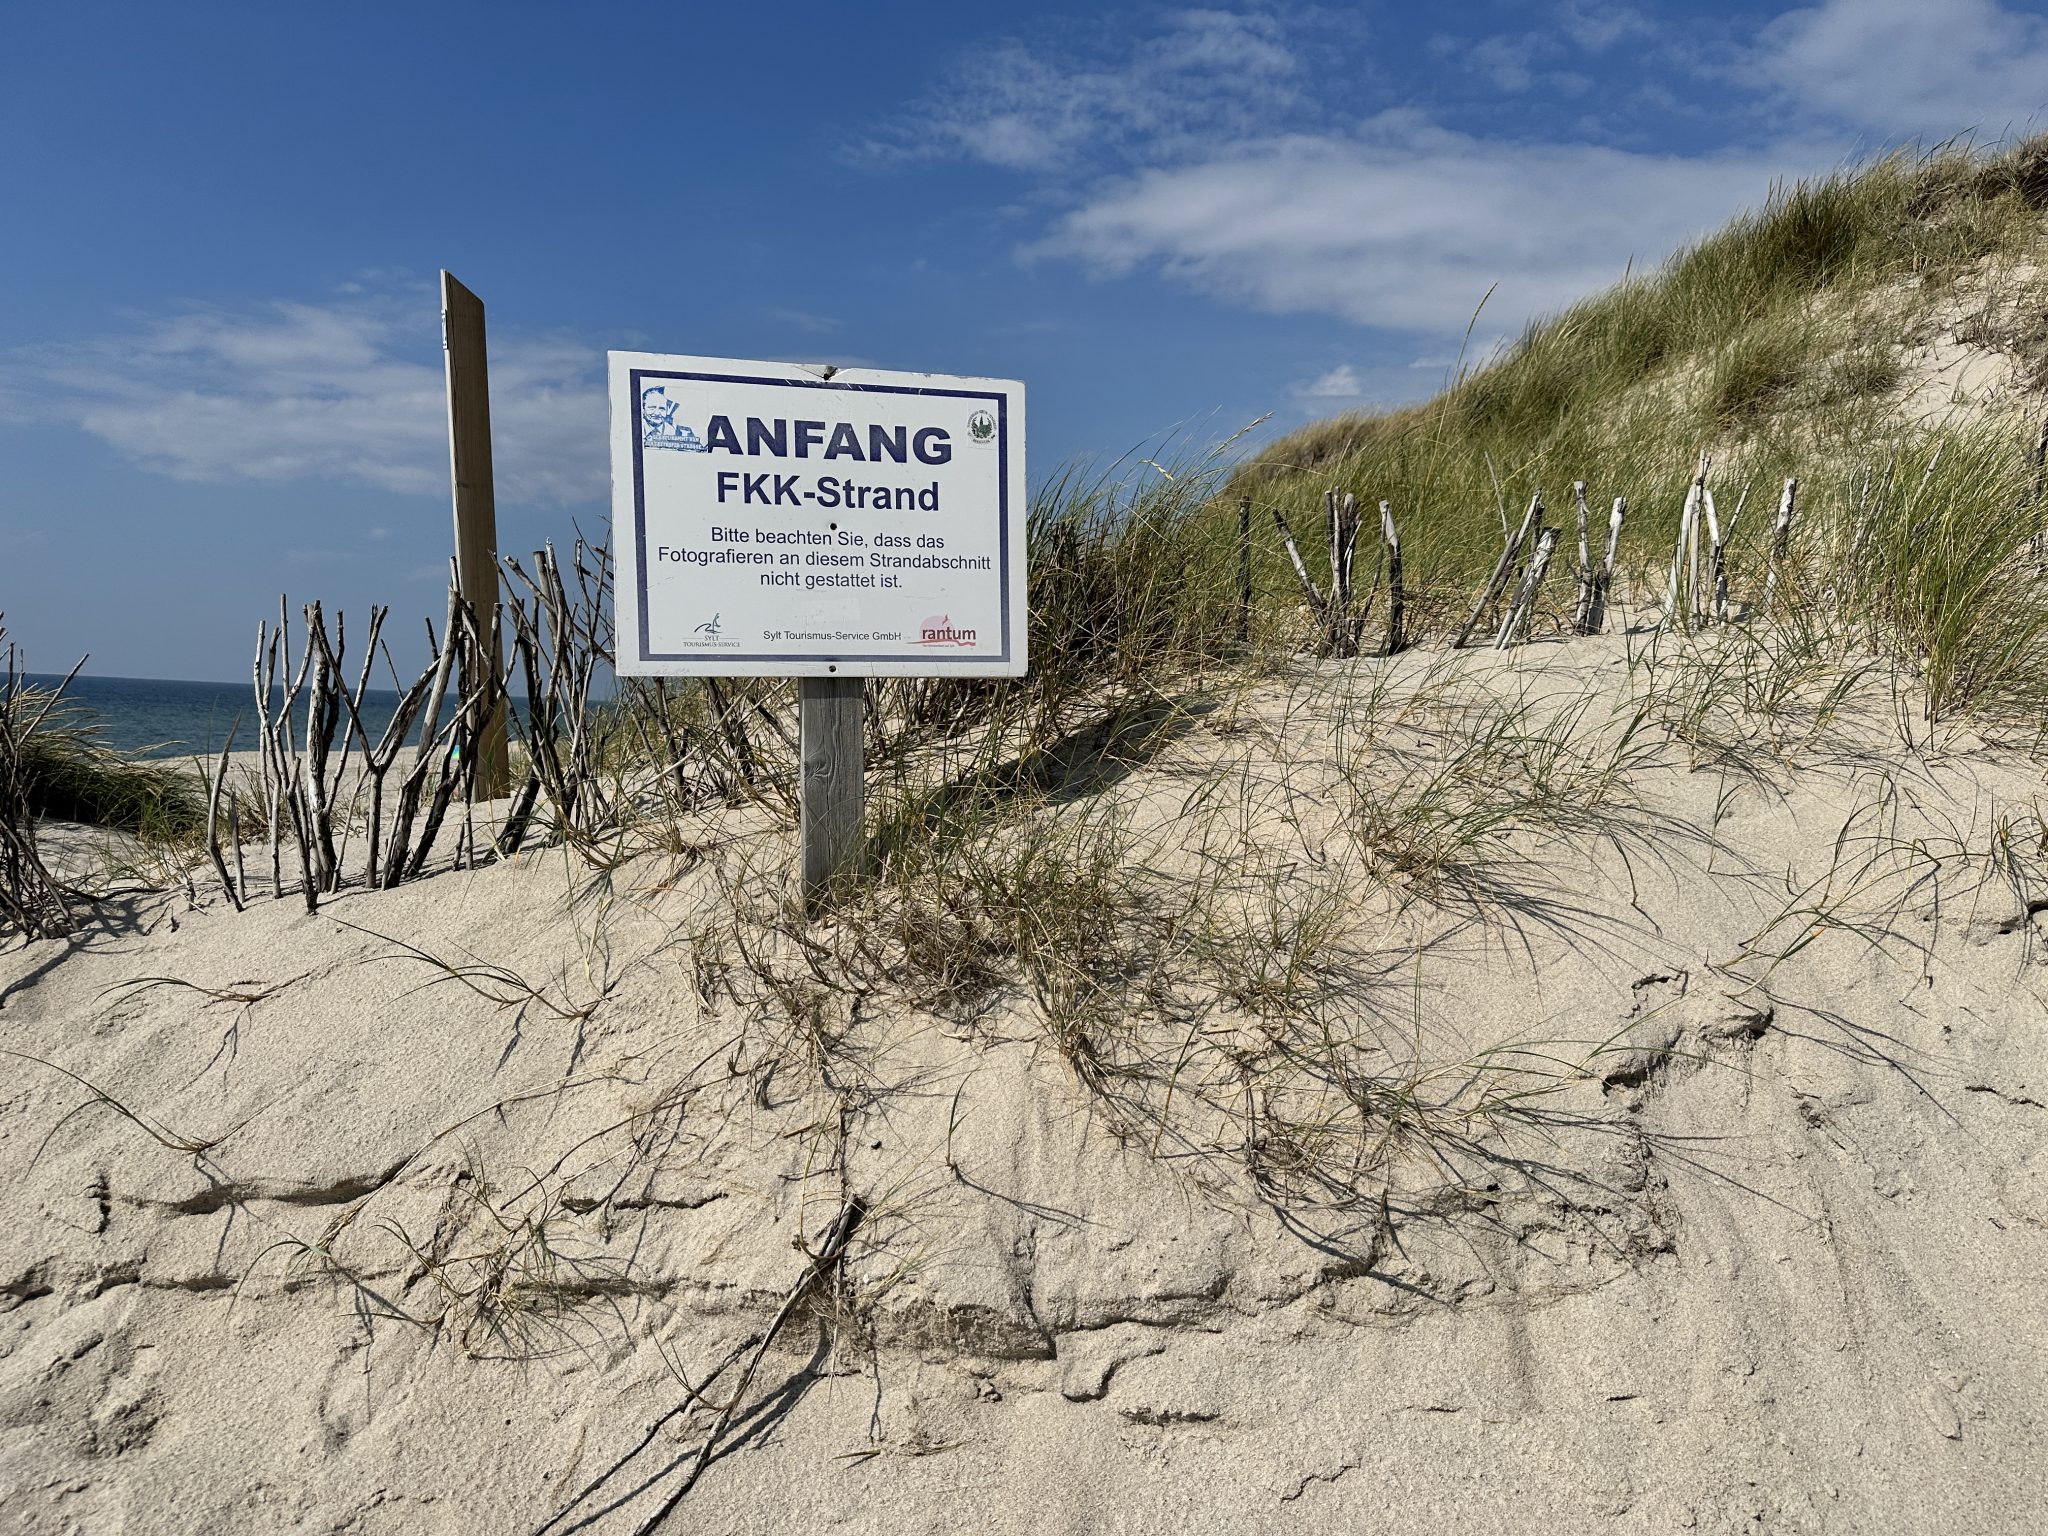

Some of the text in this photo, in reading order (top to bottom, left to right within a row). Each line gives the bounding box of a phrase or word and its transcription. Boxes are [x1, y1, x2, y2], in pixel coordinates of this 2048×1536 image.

[707, 414, 952, 466] ANFANG
[717, 471, 940, 512] FKK-Strand
[711, 526, 945, 549] Bitte beachten Sie, dass das
[658, 546, 992, 570] Fotografieren an diesem Strandabschnitt
[760, 571, 903, 589] nicht gestattet ist.
[763, 630, 902, 643] Sylt Tourismus-Service GmbH
[921, 626, 977, 640] rantum
